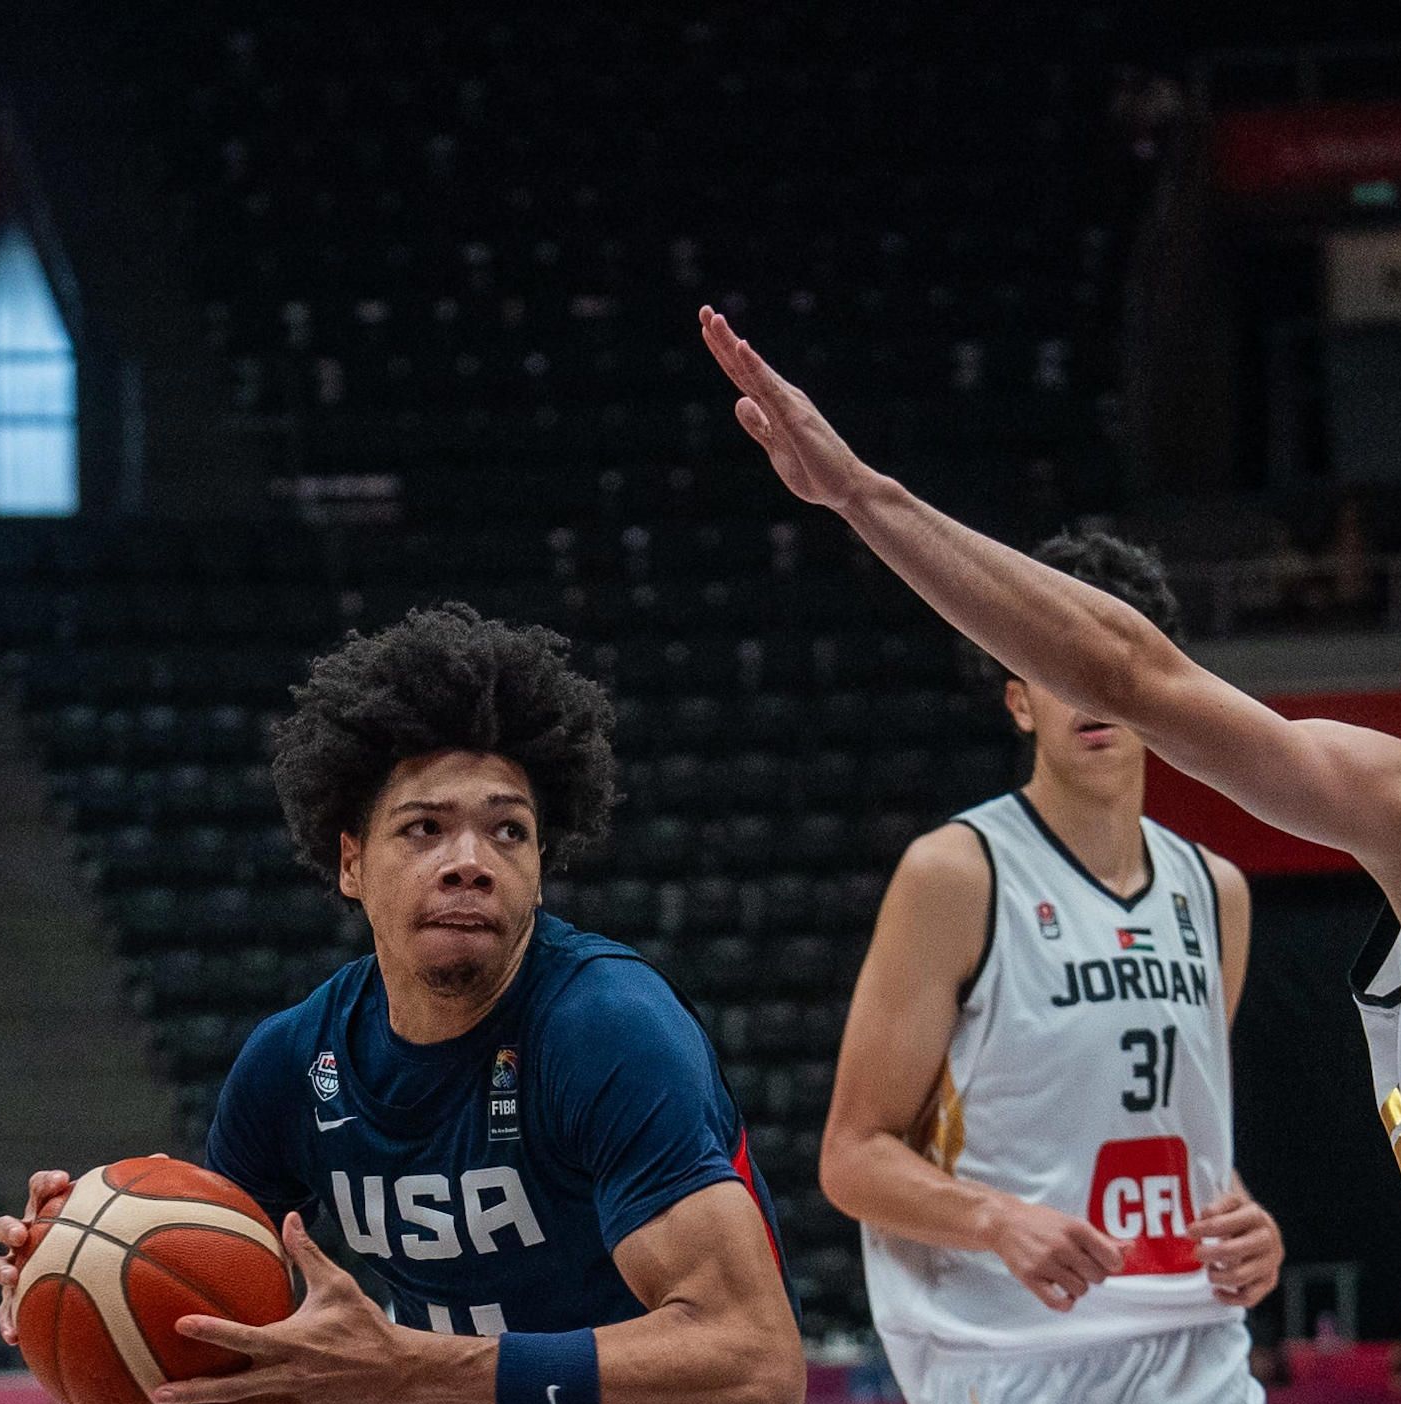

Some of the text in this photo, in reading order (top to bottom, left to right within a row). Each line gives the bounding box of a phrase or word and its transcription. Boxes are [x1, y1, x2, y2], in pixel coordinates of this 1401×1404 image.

[1051, 956, 1208, 1008] JORDAN
[1121, 1026, 1177, 1112] 31
[491, 1099, 516, 1116] FIBA
[331, 1166, 546, 1261] USA
[1102, 1175, 1187, 1240] CFI
